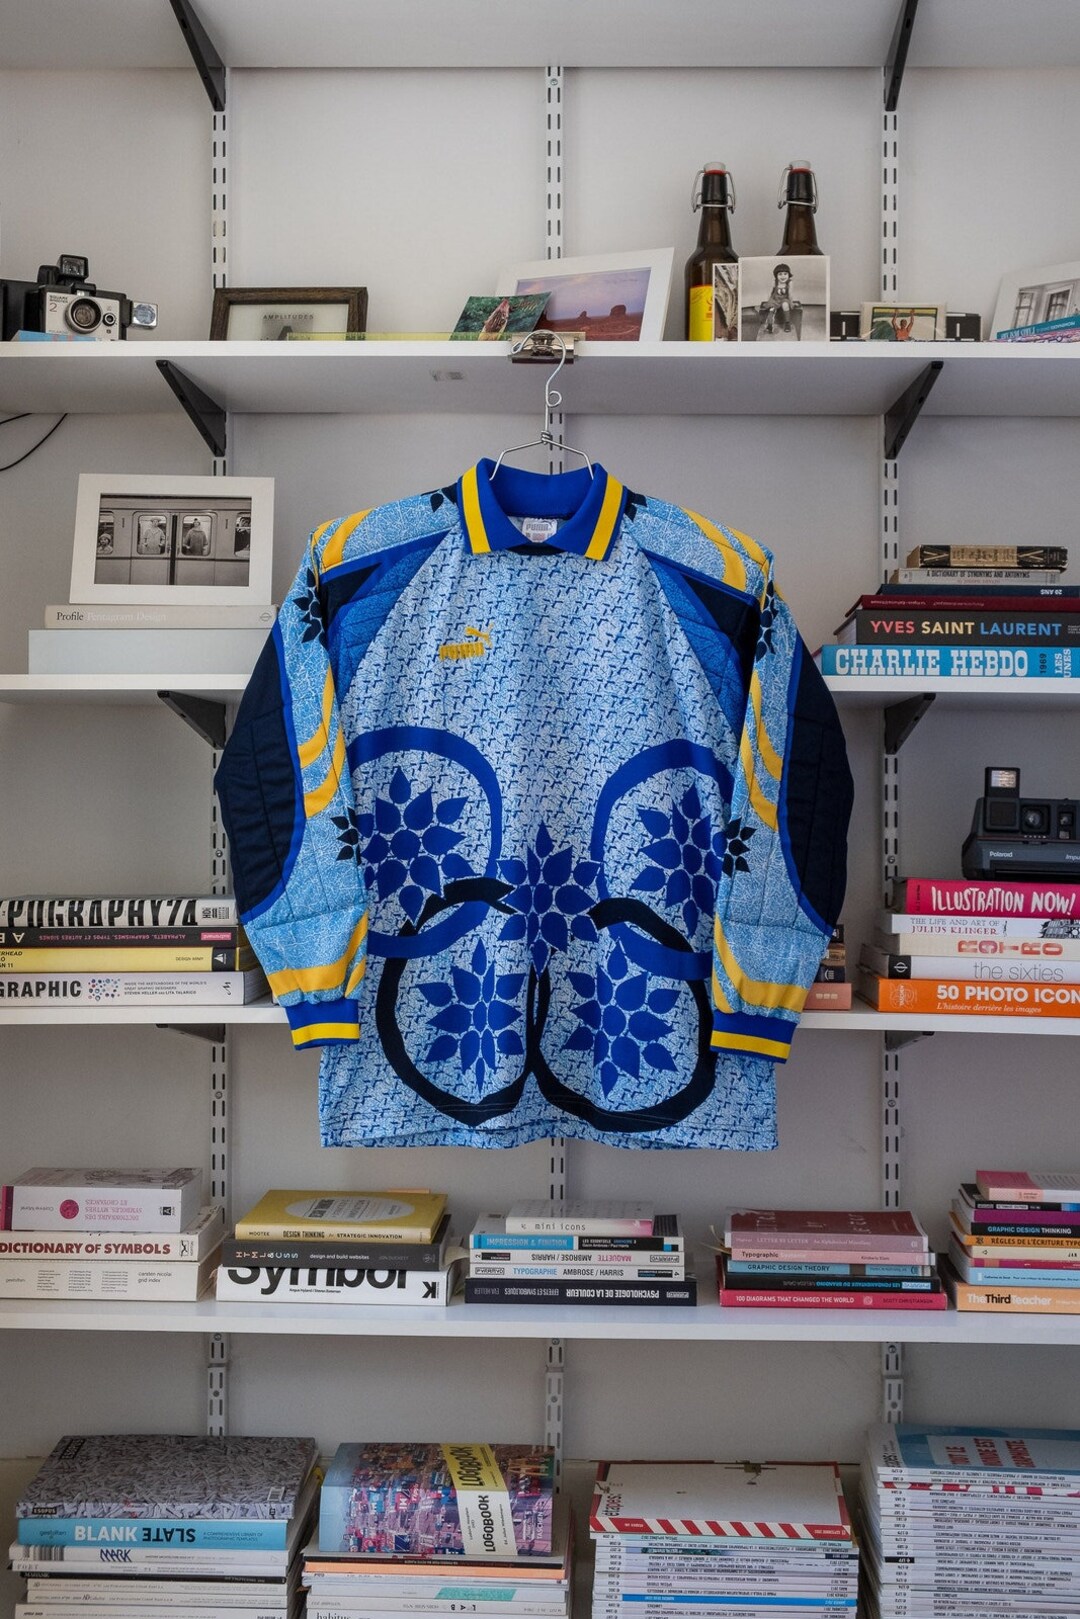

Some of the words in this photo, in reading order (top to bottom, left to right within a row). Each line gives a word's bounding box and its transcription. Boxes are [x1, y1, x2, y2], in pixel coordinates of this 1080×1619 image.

[56, 611, 84, 622] Profile
[87, 612, 134, 622] Pentagram
[136, 612, 166, 623] Design
[870, 620, 915, 634] YVES
[922, 622, 975, 635] SAINT
[980, 622, 1062, 636] LAURENT
[836, 648, 940, 676] CHARLIE
[950, 650, 1028, 677] HEBDO
[1054, 653, 1062, 674] LES
[1062, 648, 1072, 678] UNES
[931, 886, 1024, 913] ILLUSTRATION
[1031, 891, 1076, 915] NOW!
[912, 925, 946, 934] JULIUS
[950, 926, 998, 935] KLINGER
[974, 962, 1003, 981] the
[1008, 964, 1064, 983] sixties
[937, 985, 959, 1000] 50
[965, 987, 1029, 1004] PHOTO
[936, 1002, 973, 1010] L'histoire
[1015, 1006, 1042, 1014] images
[560, 1223, 586, 1231] icons
[0, 1242, 83, 1254] DICTIONARY
[85, 1244, 100, 1254] OF
[104, 1244, 170, 1255] SYMBOLS
[486, 1238, 528, 1246] IMPRESSION
[742, 1251, 779, 1260] Typographic
[513, 1268, 558, 1276] TYPOGRAPHIE
[562, 1268, 594, 1276] AMBROSE
[600, 1269, 624, 1277] HARRIS
[566, 1288, 594, 1297] COULEUR
[595, 1289, 603, 1297] LA
[604, 1289, 613, 1298] DE
[614, 1290, 660, 1298] PSYCHOLOGIE
[449, 1446, 486, 1487] LOGOBOOK
[478, 1494, 497, 1552] LOGOBOOK
[75, 1525, 138, 1542] BLANK
[142, 1527, 196, 1543] SLATE
[100, 1548, 132, 1562] MARK
